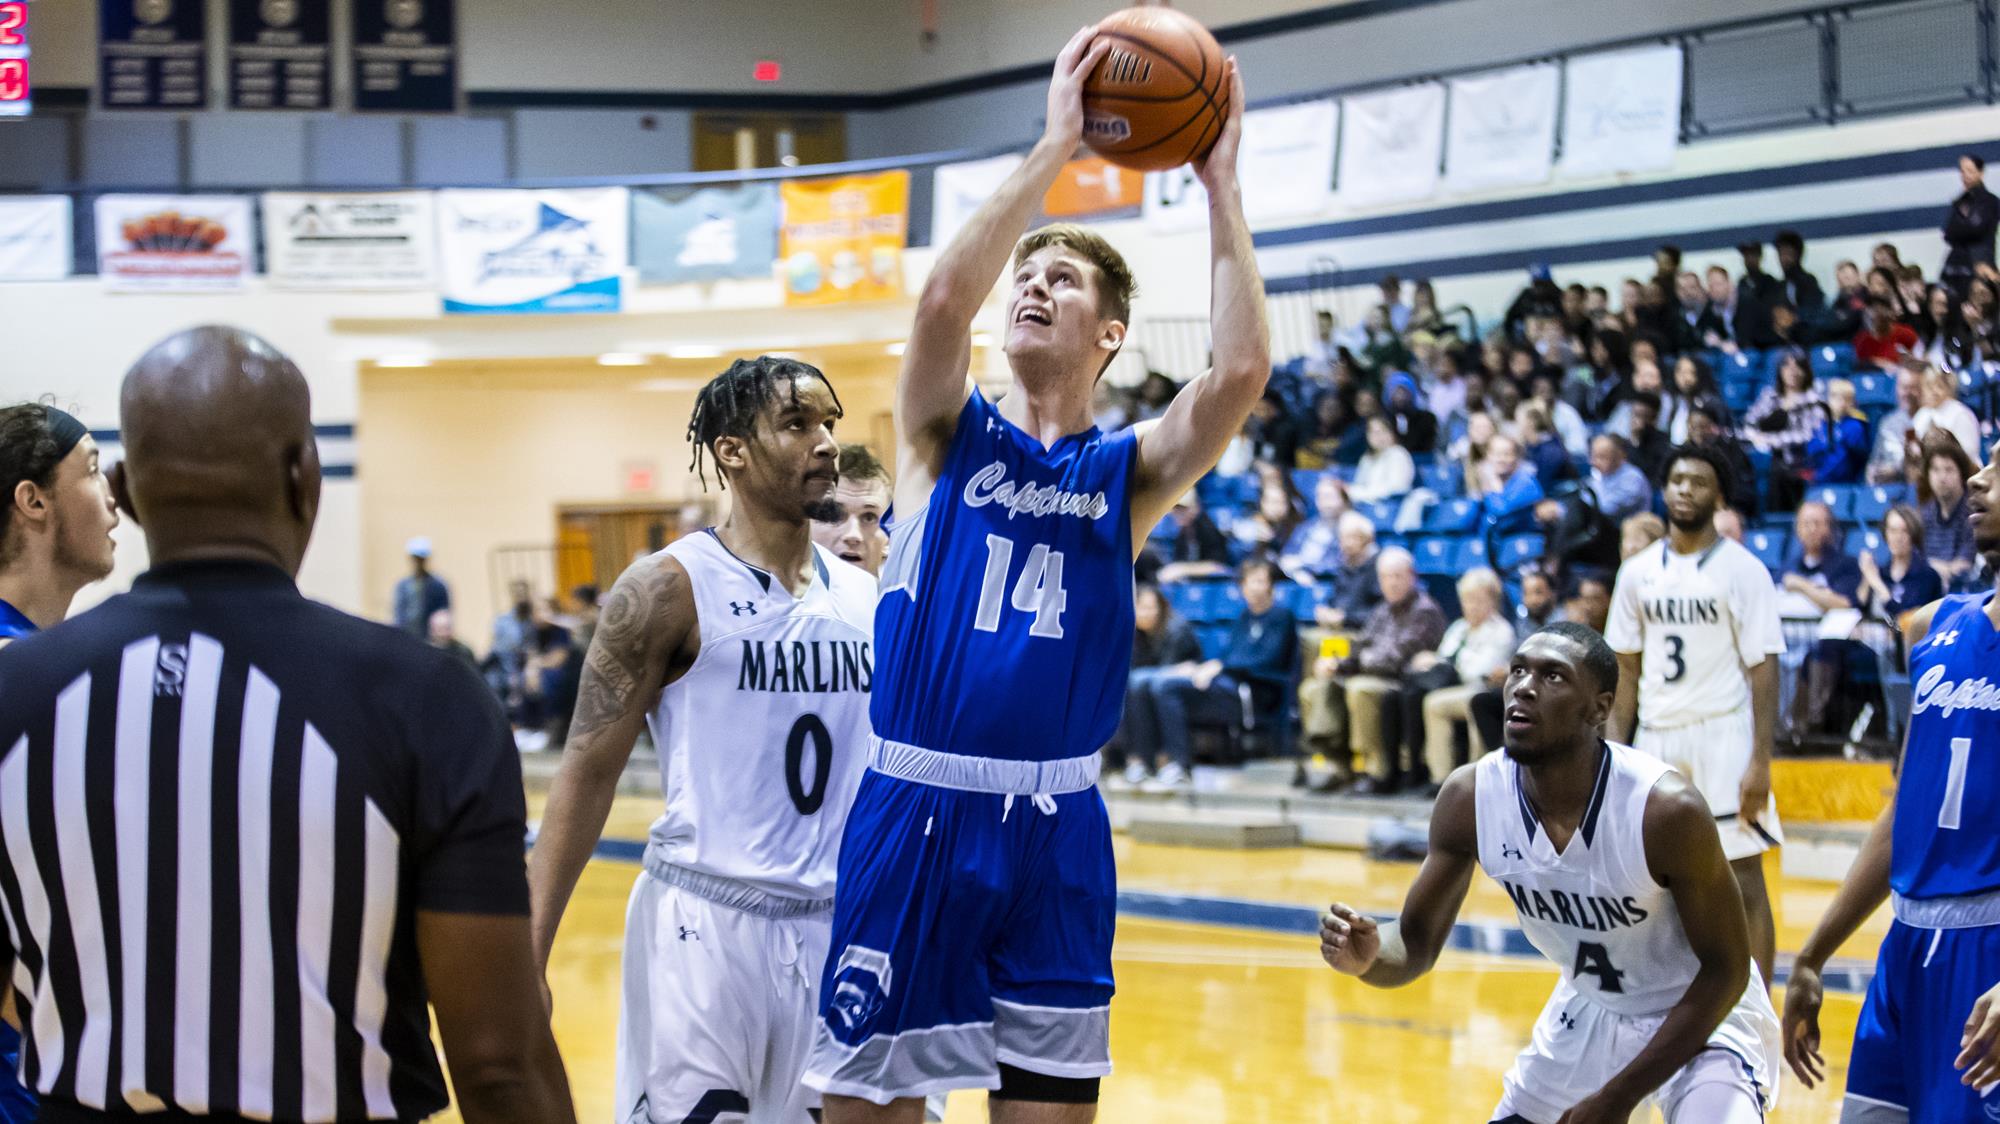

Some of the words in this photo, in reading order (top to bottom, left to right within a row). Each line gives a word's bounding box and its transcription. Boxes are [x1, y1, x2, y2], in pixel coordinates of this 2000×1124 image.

[974, 533, 1067, 639] 14
[737, 639, 872, 693] MARLINS
[1664, 635, 1686, 682] 3
[785, 712, 832, 815] 0
[1938, 737, 1971, 829] 1
[1503, 879, 1648, 932] MARLINS
[1573, 939, 1625, 994] 4
